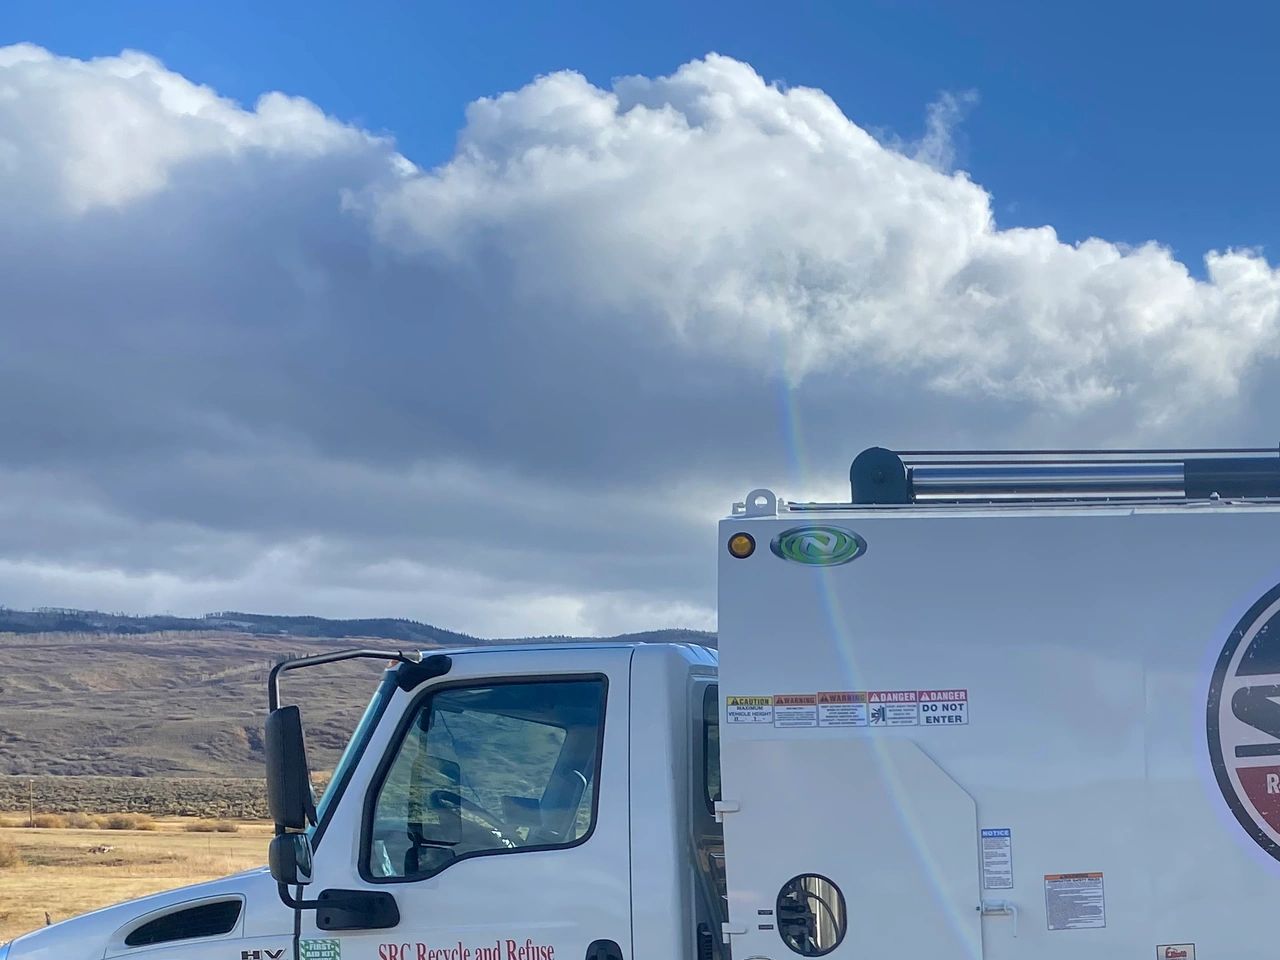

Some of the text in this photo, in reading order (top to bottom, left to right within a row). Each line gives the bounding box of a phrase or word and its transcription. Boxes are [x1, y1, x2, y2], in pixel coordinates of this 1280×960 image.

[880, 692, 916, 702] DANGER
[930, 691, 966, 700] DANGER
[922, 703, 965, 712] DO NOT
[925, 715, 963, 724] ENTER
[241, 949, 286, 960] HV
